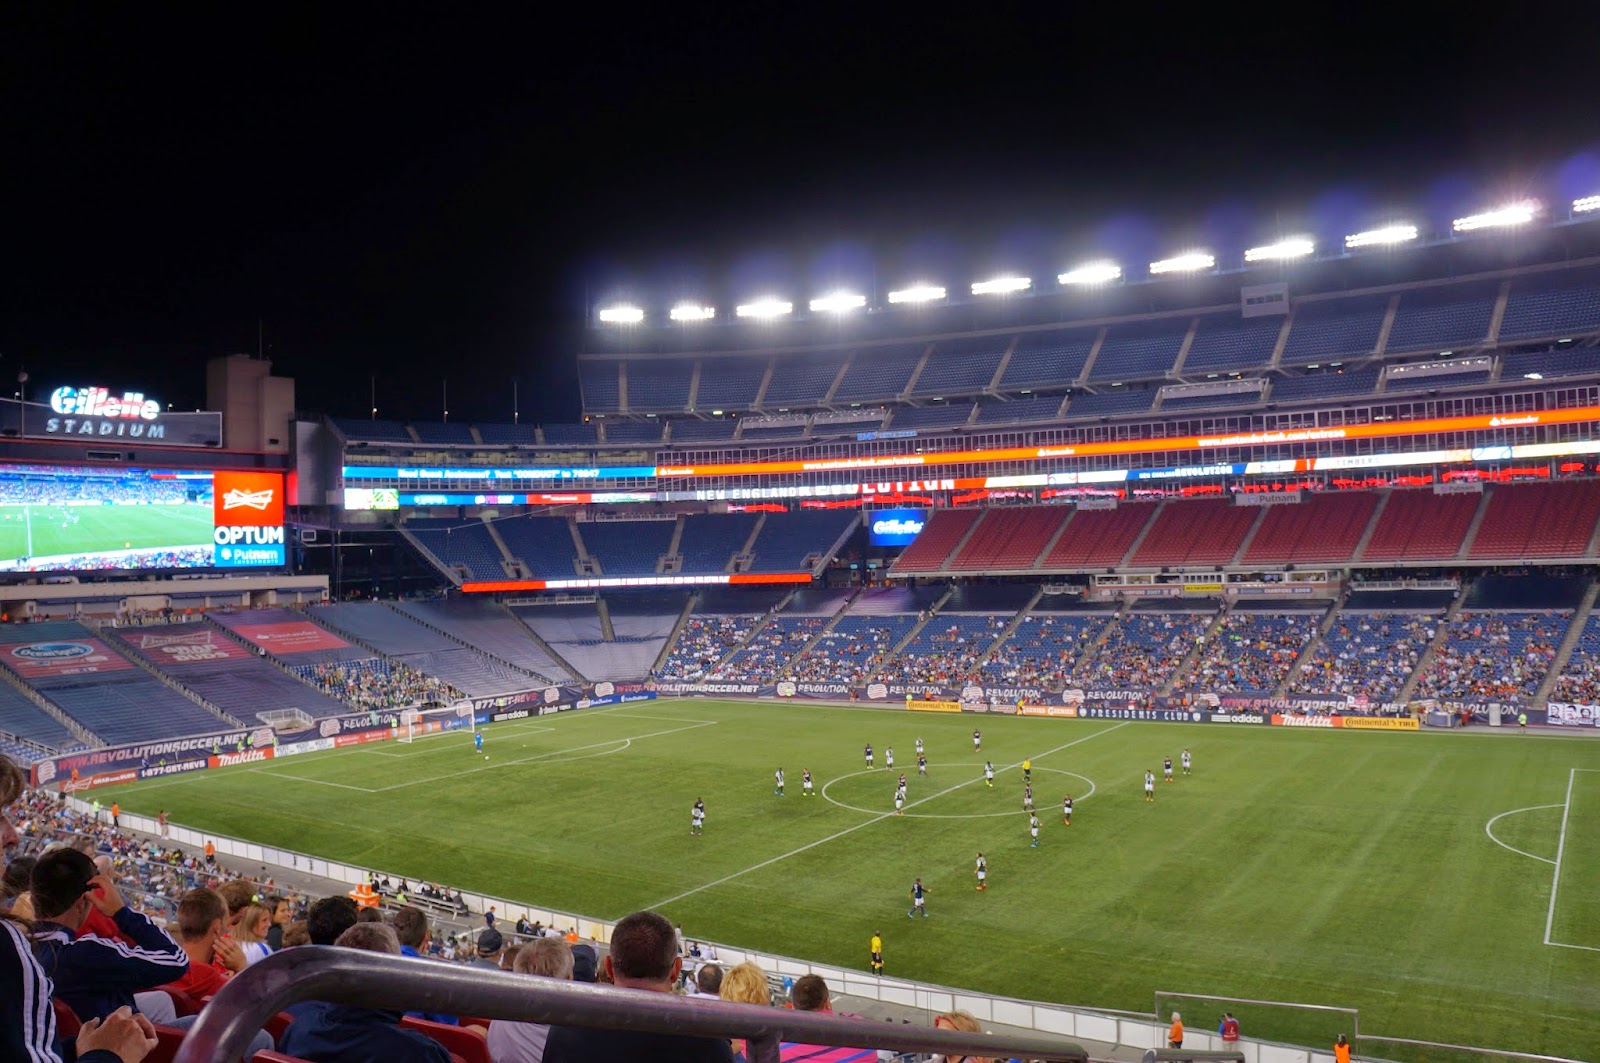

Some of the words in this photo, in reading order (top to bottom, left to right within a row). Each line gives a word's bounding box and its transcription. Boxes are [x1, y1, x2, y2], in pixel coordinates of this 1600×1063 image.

[50, 386, 160, 420] Gillette
[1501, 416, 1539, 425] Santander
[46, 417, 166, 438] STADIUM
[696, 489, 724, 501] NEW
[732, 487, 796, 500] ENGLAND
[1259, 494, 1296, 503] Putnam
[873, 519, 923, 535] Gillette
[214, 526, 284, 545] OPTUM
[233, 549, 278, 560] Putnam
[797, 684, 848, 693] REVOLUTION
[889, 685, 941, 695] REVOLUTION
[985, 688, 1041, 698] REVOLUTION
[507, 710, 529, 719] adidas
[1090, 709, 1157, 720] PRESIDENTS
[1164, 711, 1189, 720] CLUB
[1231, 714, 1264, 724] adidas
[1345, 718, 1389, 727] Continental
[141, 759, 206, 777] 1-877-GET-REVS
